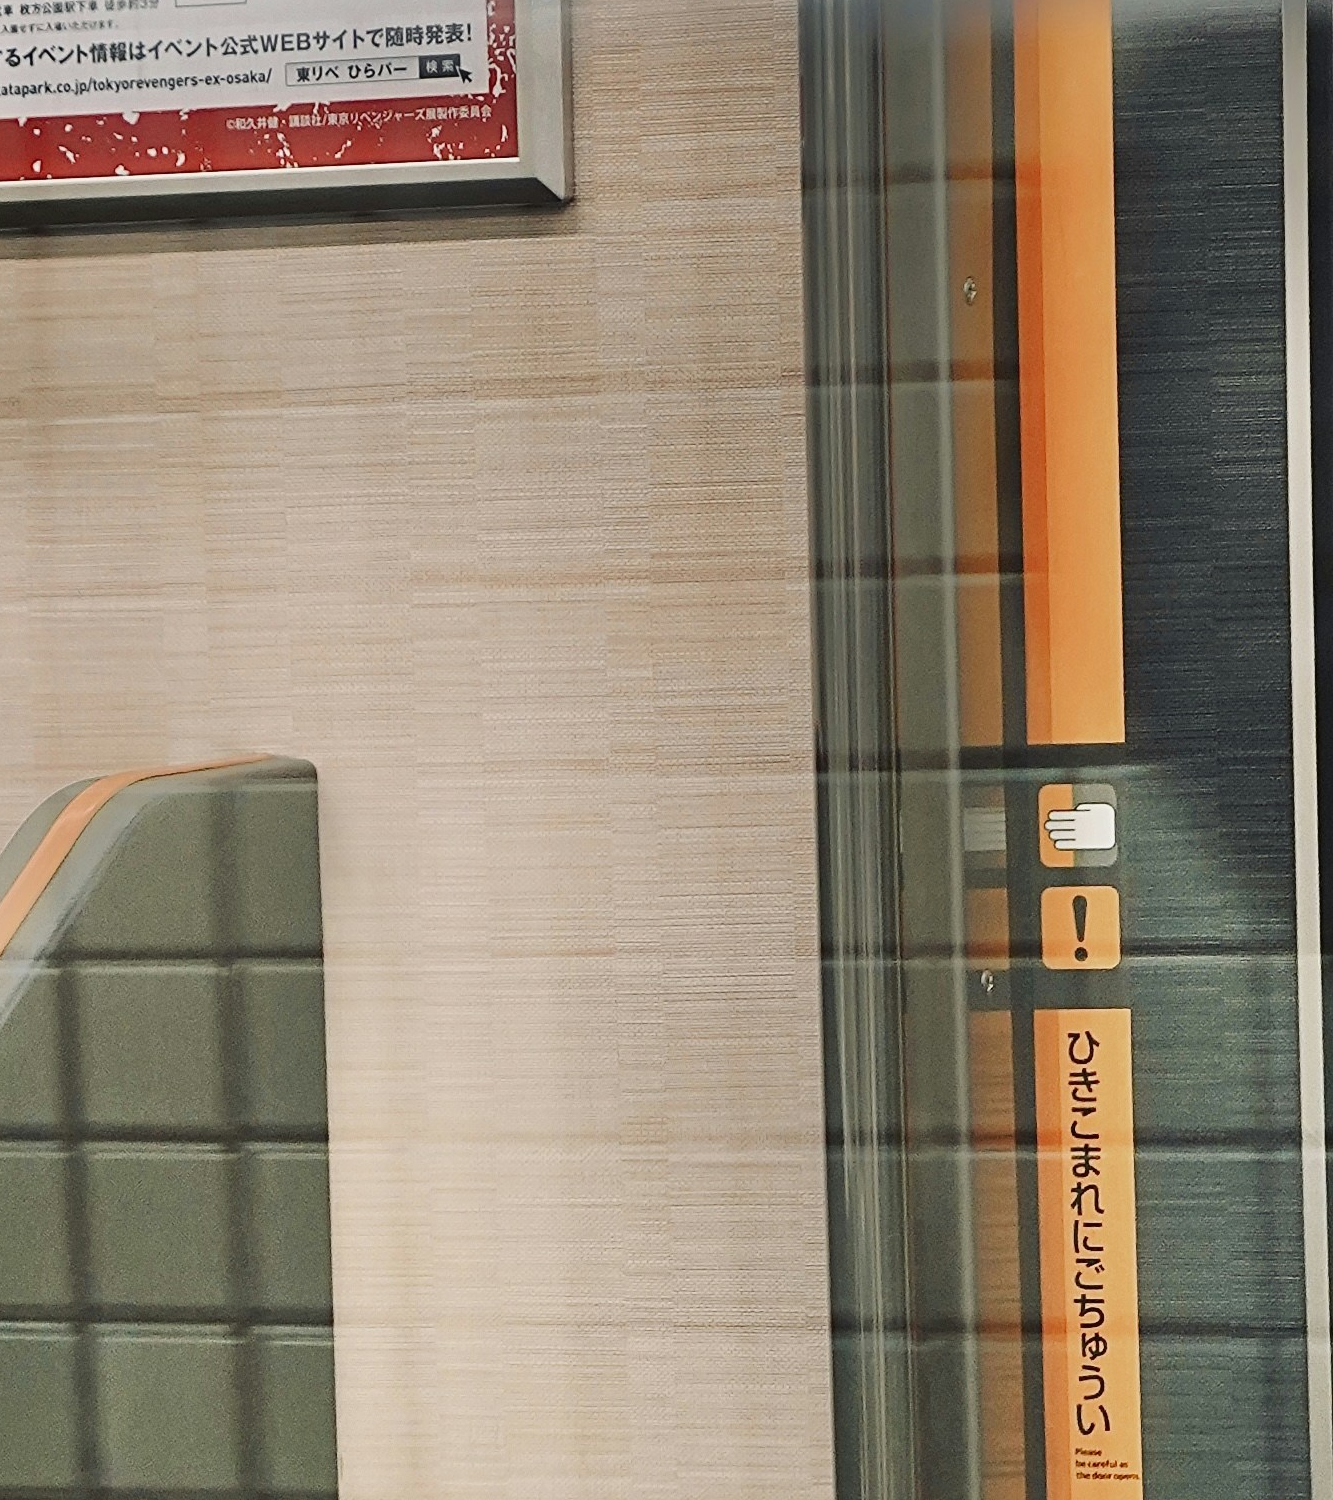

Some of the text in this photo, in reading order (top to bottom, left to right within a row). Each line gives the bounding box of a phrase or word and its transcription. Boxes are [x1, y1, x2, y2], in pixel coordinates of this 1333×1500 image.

[1067, 1029, 1111, 1437] ひきこまれにごちゅうい
